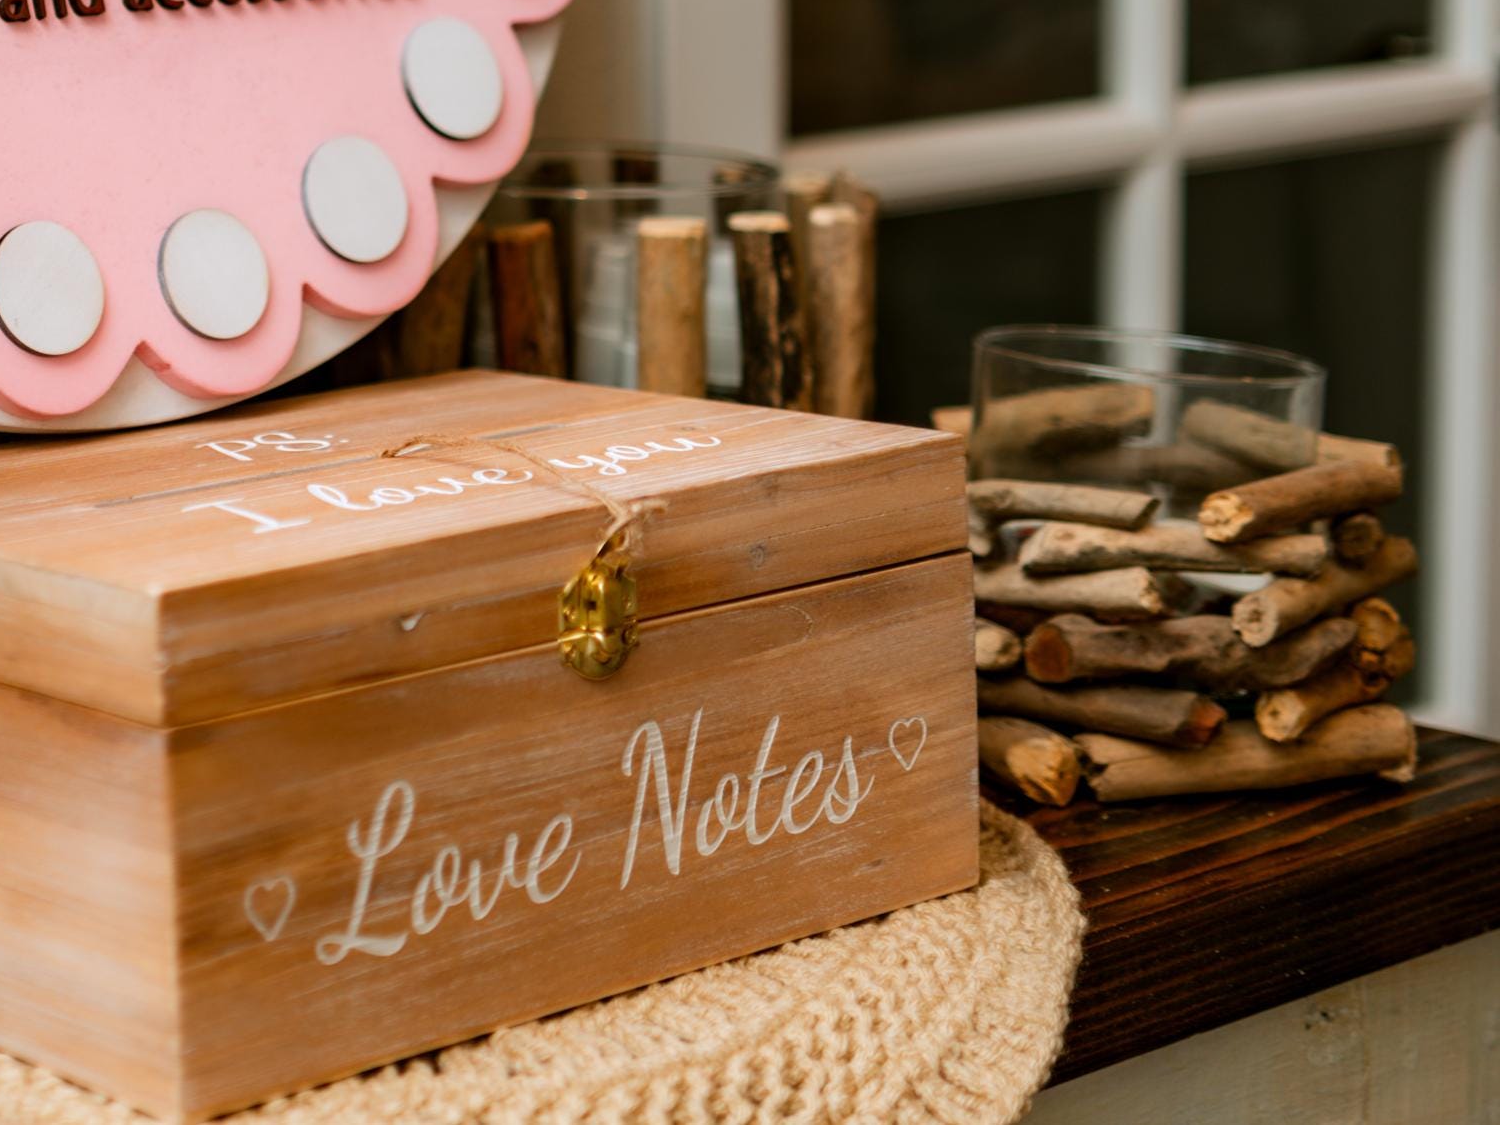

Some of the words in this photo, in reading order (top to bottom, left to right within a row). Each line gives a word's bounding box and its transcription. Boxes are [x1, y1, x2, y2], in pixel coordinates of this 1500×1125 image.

[182, 497, 312, 535] I
[307, 466, 534, 511] love
[548, 435, 722, 476] you
[315, 780, 582, 966] Love
[619, 707, 875, 890] Notes
